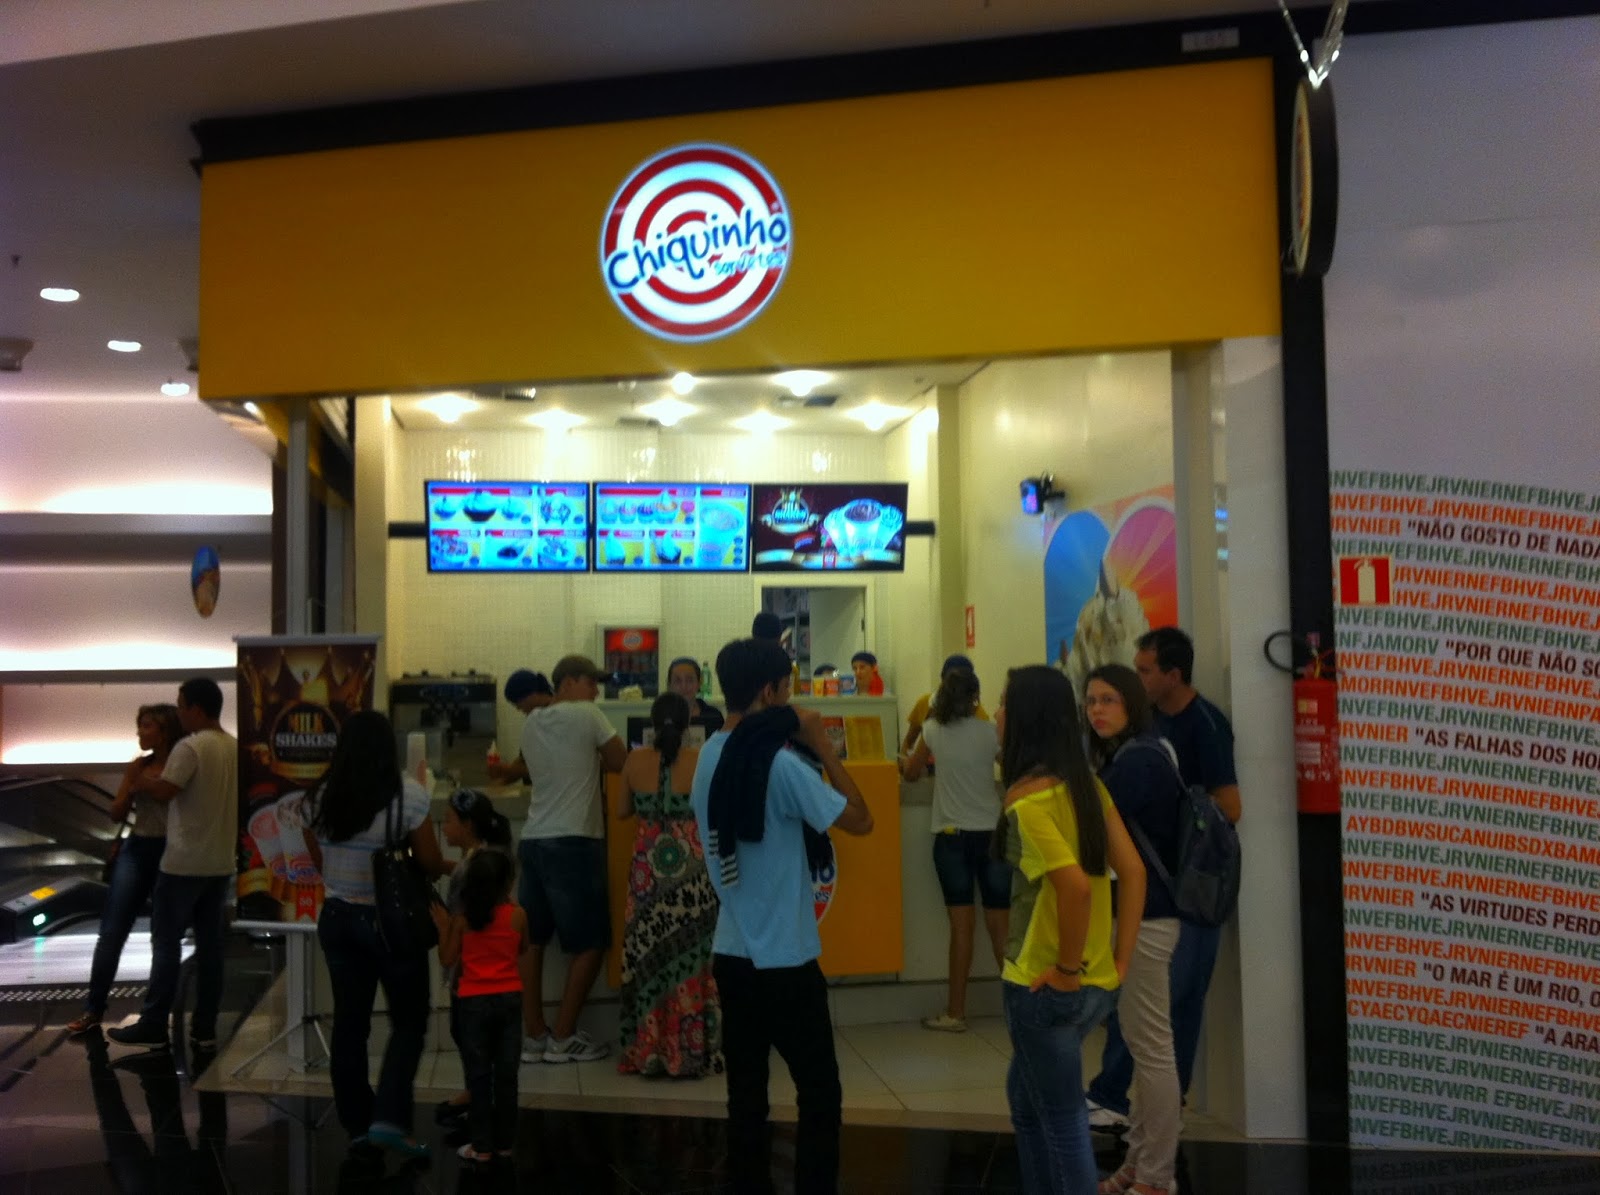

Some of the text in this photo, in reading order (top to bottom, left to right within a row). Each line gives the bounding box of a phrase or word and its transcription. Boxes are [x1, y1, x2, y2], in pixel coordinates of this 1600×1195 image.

[608, 209, 787, 289] Chiquinho
[1407, 518, 1455, 541] "NÃO
[1461, 526, 1520, 548] GOSTO
[1526, 533, 1550, 553] DE
[1335, 608, 1600, 653] NVEFBHVEJRVNIERNEFBHVEJ
[1445, 639, 1491, 661] "POR
[1498, 644, 1532, 666] QUE
[1539, 648, 1576, 673] NÃO
[1339, 744, 1600, 795] NVEFBHVEJRVNIERNEFBHVE
[1415, 727, 1449, 748] "AS
[1454, 732, 1523, 758] FALHAS
[1530, 744, 1566, 764] DOS
[1571, 749, 1600, 771] HO
[1340, 767, 1600, 818] NVEFBHVEJRVNIERNEFBHVE
[1341, 790, 1600, 841] NVEFBHVEJRVNIERNEFBHVE
[1342, 837, 1600, 889] NVEFBHVEJRVNIERNEFBHVE
[1421, 891, 1454, 912] "AS
[1460, 898, 1547, 927] VIRTUDES
[1423, 961, 1444, 981] "O
[1450, 966, 1491, 989] MAR
[1498, 969, 1510, 991] É
[1514, 976, 1542, 998] UM
[1548, 984, 1585, 1009] RIO,
[1535, 1024, 1557, 1046] "A
